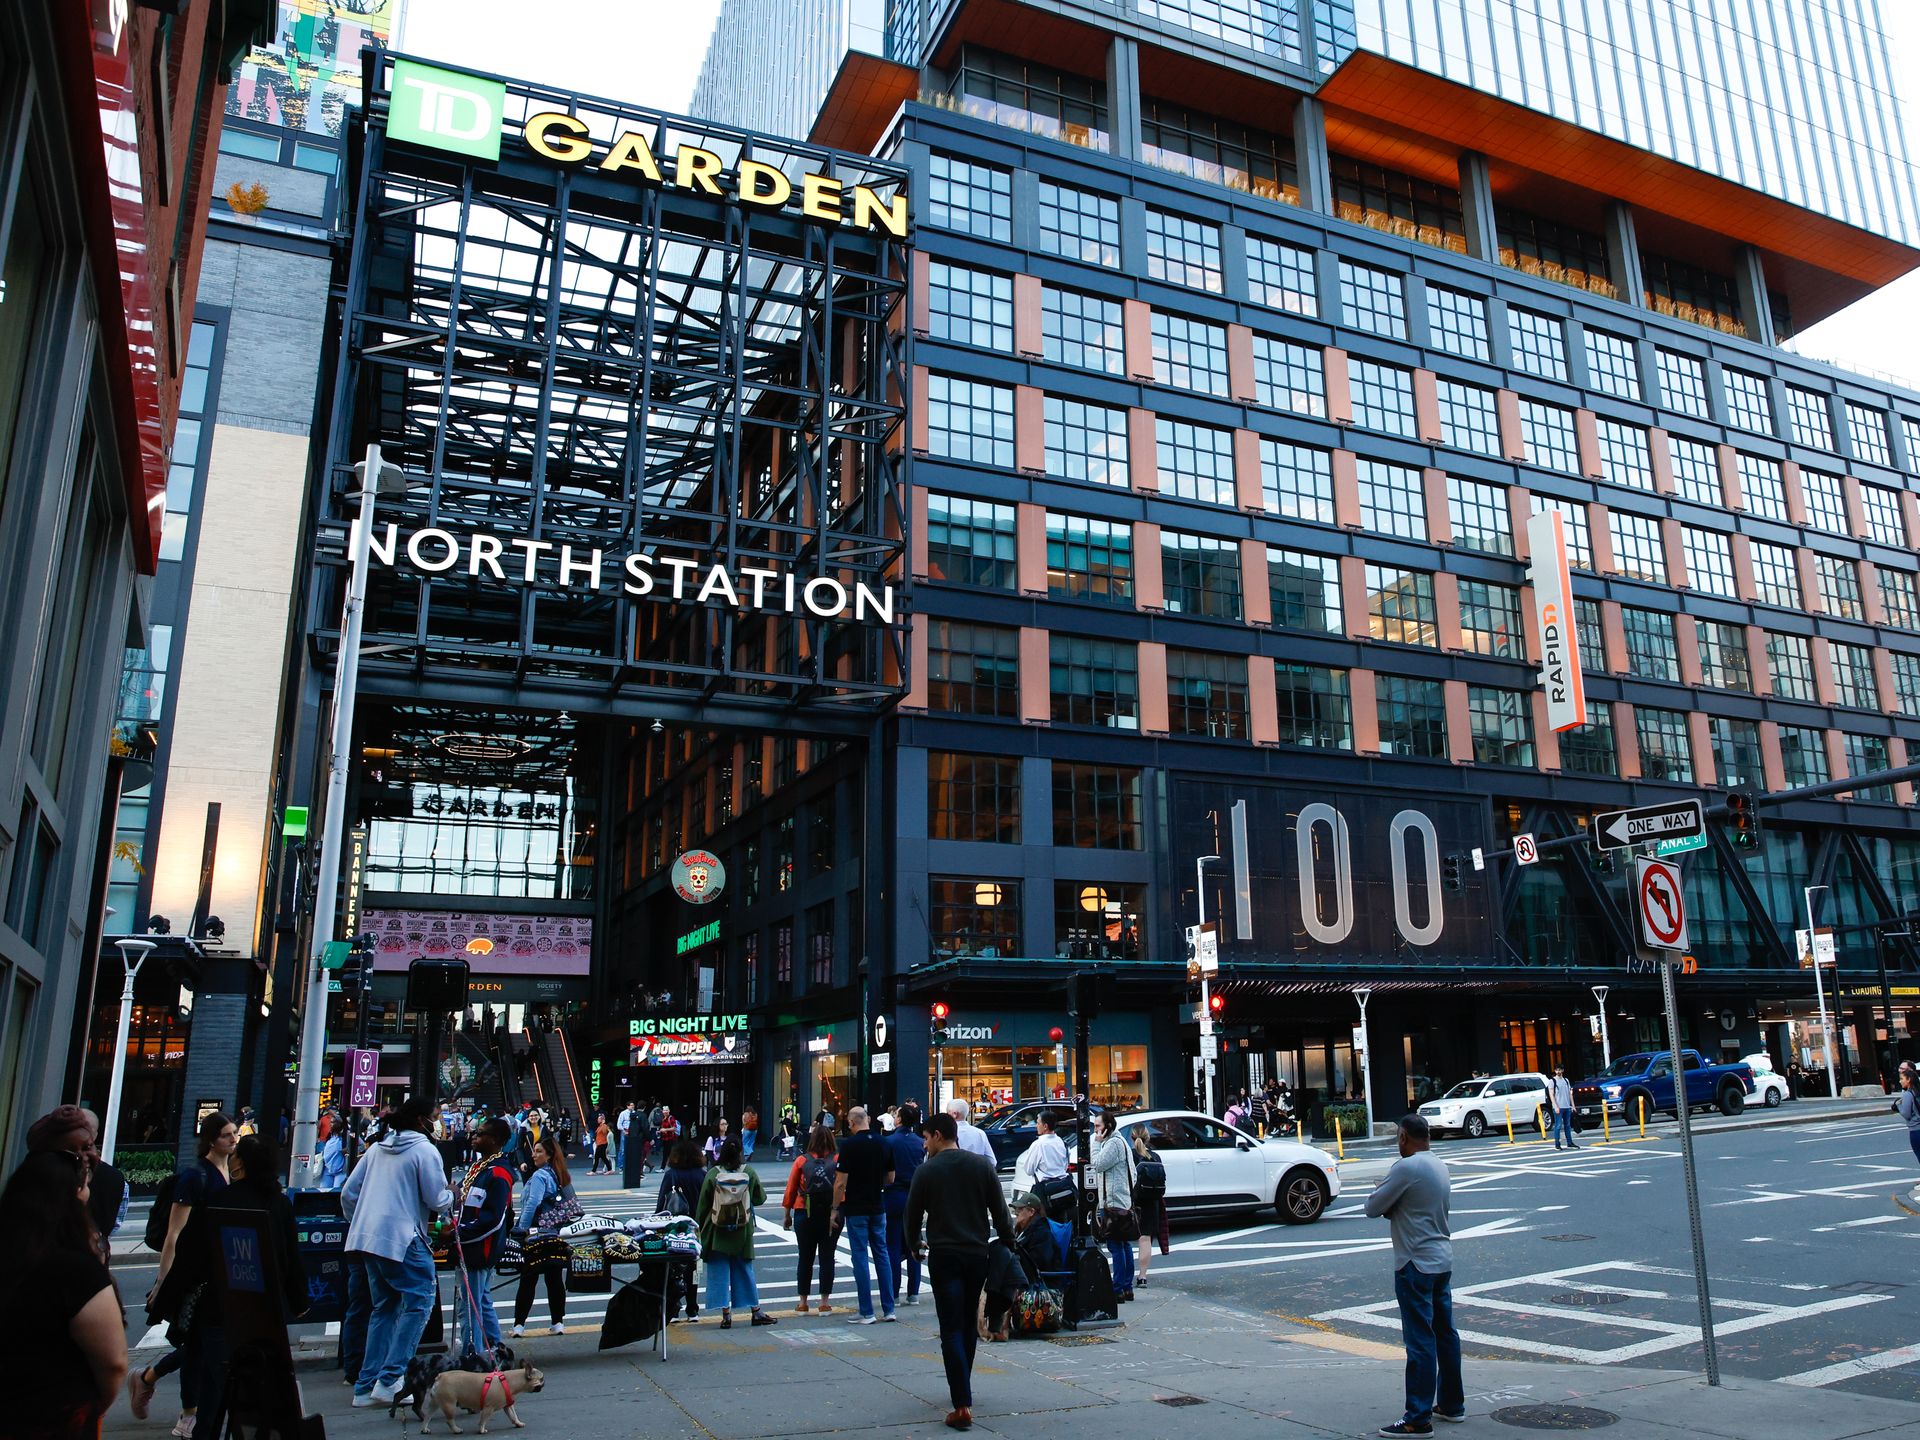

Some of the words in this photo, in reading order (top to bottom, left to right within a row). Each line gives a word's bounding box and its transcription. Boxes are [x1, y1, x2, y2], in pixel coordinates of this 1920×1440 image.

[404, 77, 492, 142] TD
[524, 112, 908, 237] GARDEN
[348, 518, 601, 590] NORTH
[624, 552, 893, 625] STATION
[1543, 602, 1566, 704] RAPID7
[1628, 818, 1655, 835] ONE
[1662, 812, 1691, 830] WAY
[1657, 836, 1691, 851] ANAL
[1231, 799, 1444, 946] 100
[345, 842, 362, 940] BANNERS
[687, 926, 706, 951] NIGHT
[706, 919, 720, 942] LIVE
[468, 983, 502, 991] RDEN
[630, 1019, 656, 1036] BIG
[659, 1016, 709, 1034] NIGHT
[713, 1014, 748, 1031] LIVE
[931, 1023, 992, 1040] erizon
[652, 1042, 679, 1055] NOW
[681, 1040, 712, 1055] OPEN
[1239, 1038, 1249, 1047] 100
[362, 1058, 370, 1071] T
[570, 1218, 616, 1235] BOSTON
[232, 1236, 252, 1260] JW
[671, 1241, 690, 1249] BOSTON
